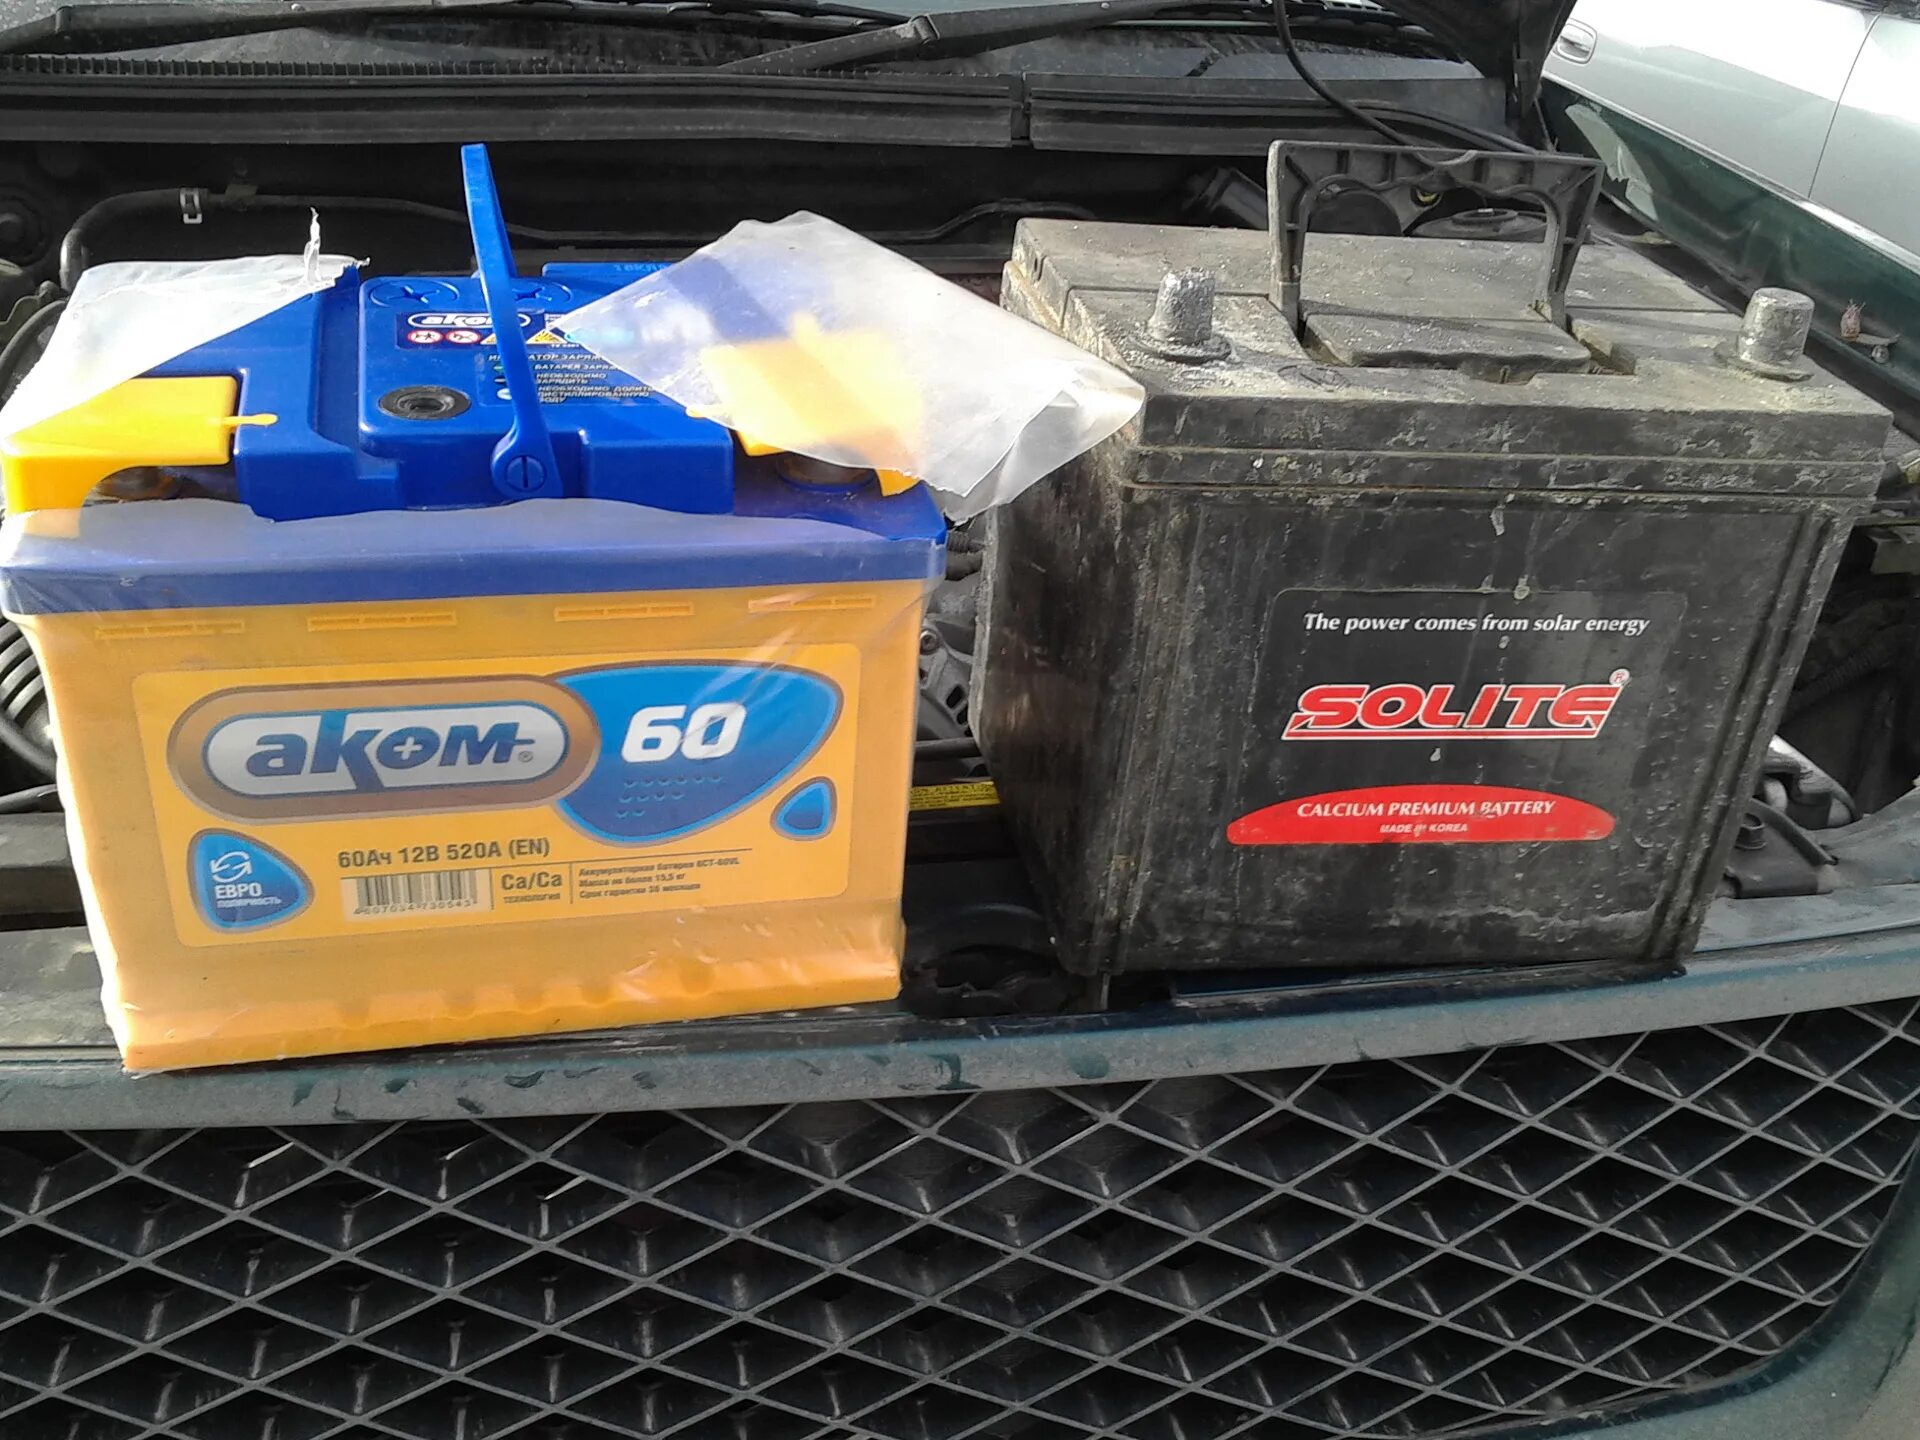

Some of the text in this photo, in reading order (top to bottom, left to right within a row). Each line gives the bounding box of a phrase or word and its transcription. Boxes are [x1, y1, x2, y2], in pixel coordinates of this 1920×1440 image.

[1303, 613, 1651, 637] The power comes from solar energy
[1284, 684, 1621, 738] SOLITE
[621, 702, 747, 763] 60
[1297, 800, 1556, 818] CALCIUM PREMIUM BATTERY
[1380, 823, 1412, 834] MADE
[1429, 823, 1469, 833] KOREA
[338, 850, 392, 868] 60Ач
[508, 837, 550, 860] (EN)
[214, 882, 263, 899] ЕВРО
[501, 871, 562, 890] Ca/Ca
